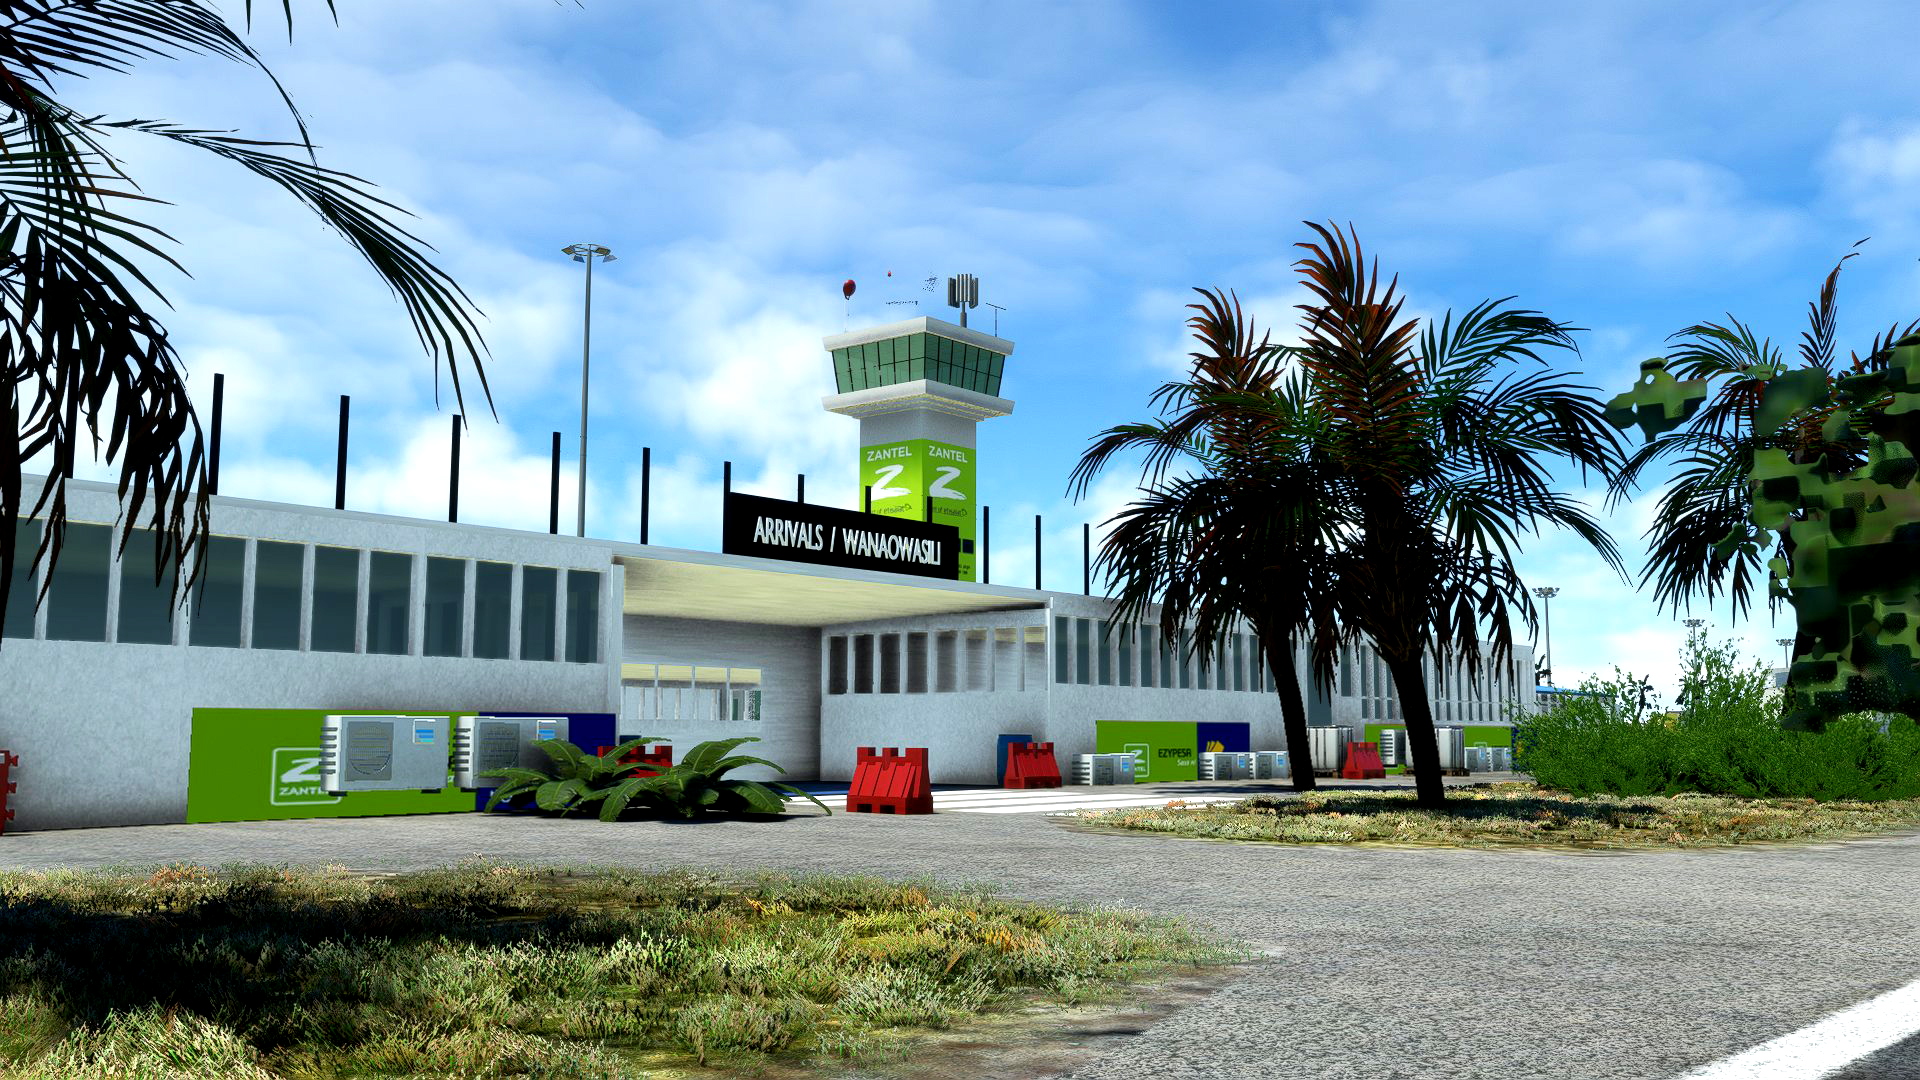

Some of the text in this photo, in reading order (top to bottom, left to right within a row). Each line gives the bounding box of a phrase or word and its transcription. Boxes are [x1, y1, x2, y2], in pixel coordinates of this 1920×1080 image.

[867, 446, 912, 462] ZANTEL
[928, 445, 968, 463] ZANTEL
[753, 516, 942, 566] ARRIVALS / WANAOWASILI
